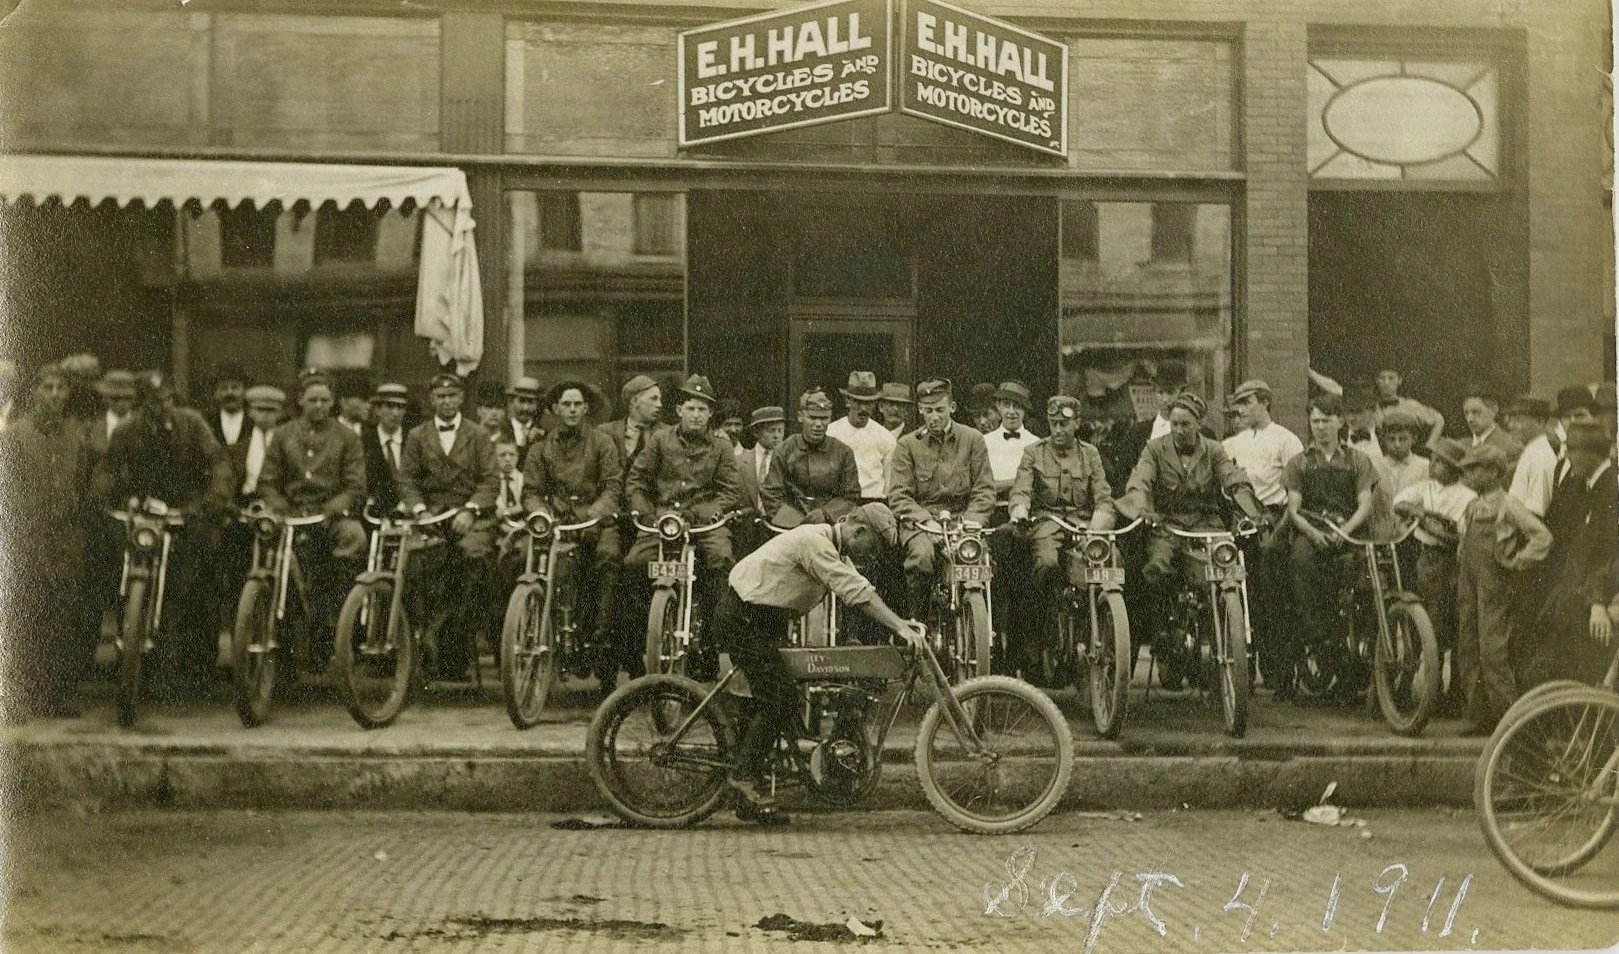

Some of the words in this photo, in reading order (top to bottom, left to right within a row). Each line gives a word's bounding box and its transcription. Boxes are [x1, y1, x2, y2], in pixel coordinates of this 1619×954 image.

[690, 63, 834, 106] BICYCLES
[840, 54, 880, 78] AND
[698, 79, 870, 128] MOTORCYCLES
[911, 54, 1023, 105] BICYCLES
[1028, 90, 1056, 119] AND
[915, 82, 1053, 139] MOTORCYCLES
[955, 567, 980, 580] 349
